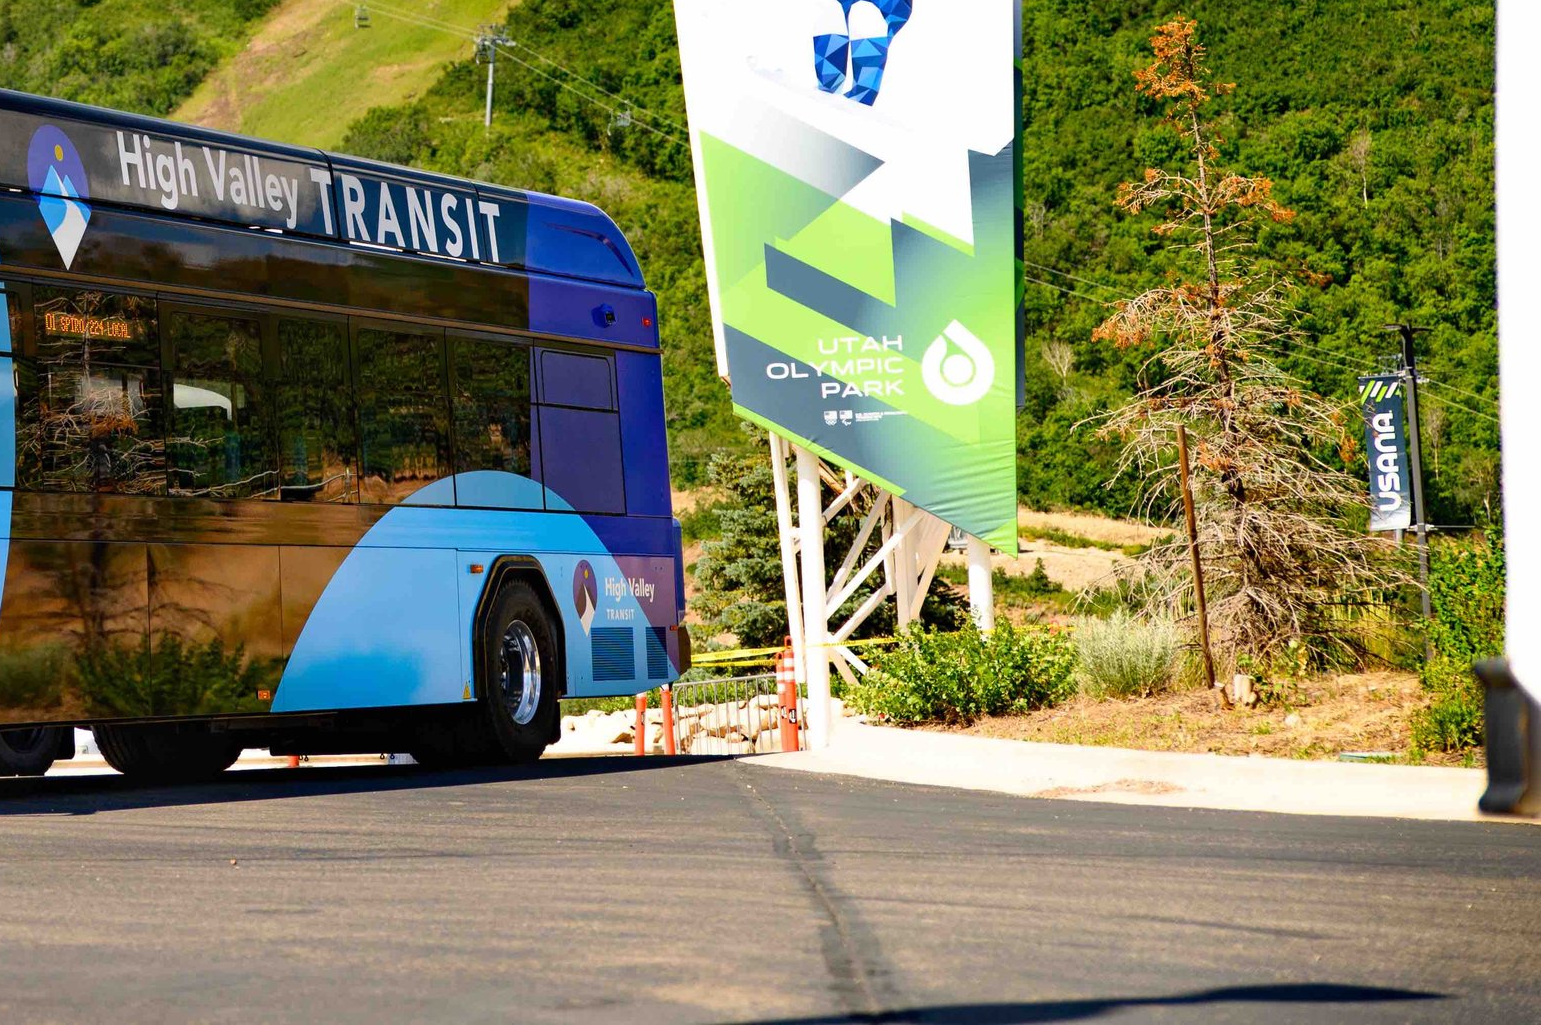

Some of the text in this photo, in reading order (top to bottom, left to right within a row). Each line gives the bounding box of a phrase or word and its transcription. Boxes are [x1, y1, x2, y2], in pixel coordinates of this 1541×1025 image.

[116, 130, 298, 231] High Valley
[310, 168, 501, 264] TRANSIT
[107, 321, 131, 339] LOCAL
[817, 334, 903, 356] UTAH
[765, 356, 905, 381] OLYMPIC
[820, 379, 905, 400] PARK
[1372, 410, 1402, 512] USANA
[604, 576, 655, 603] High Valley
[606, 608, 635, 621] TRANSIT
